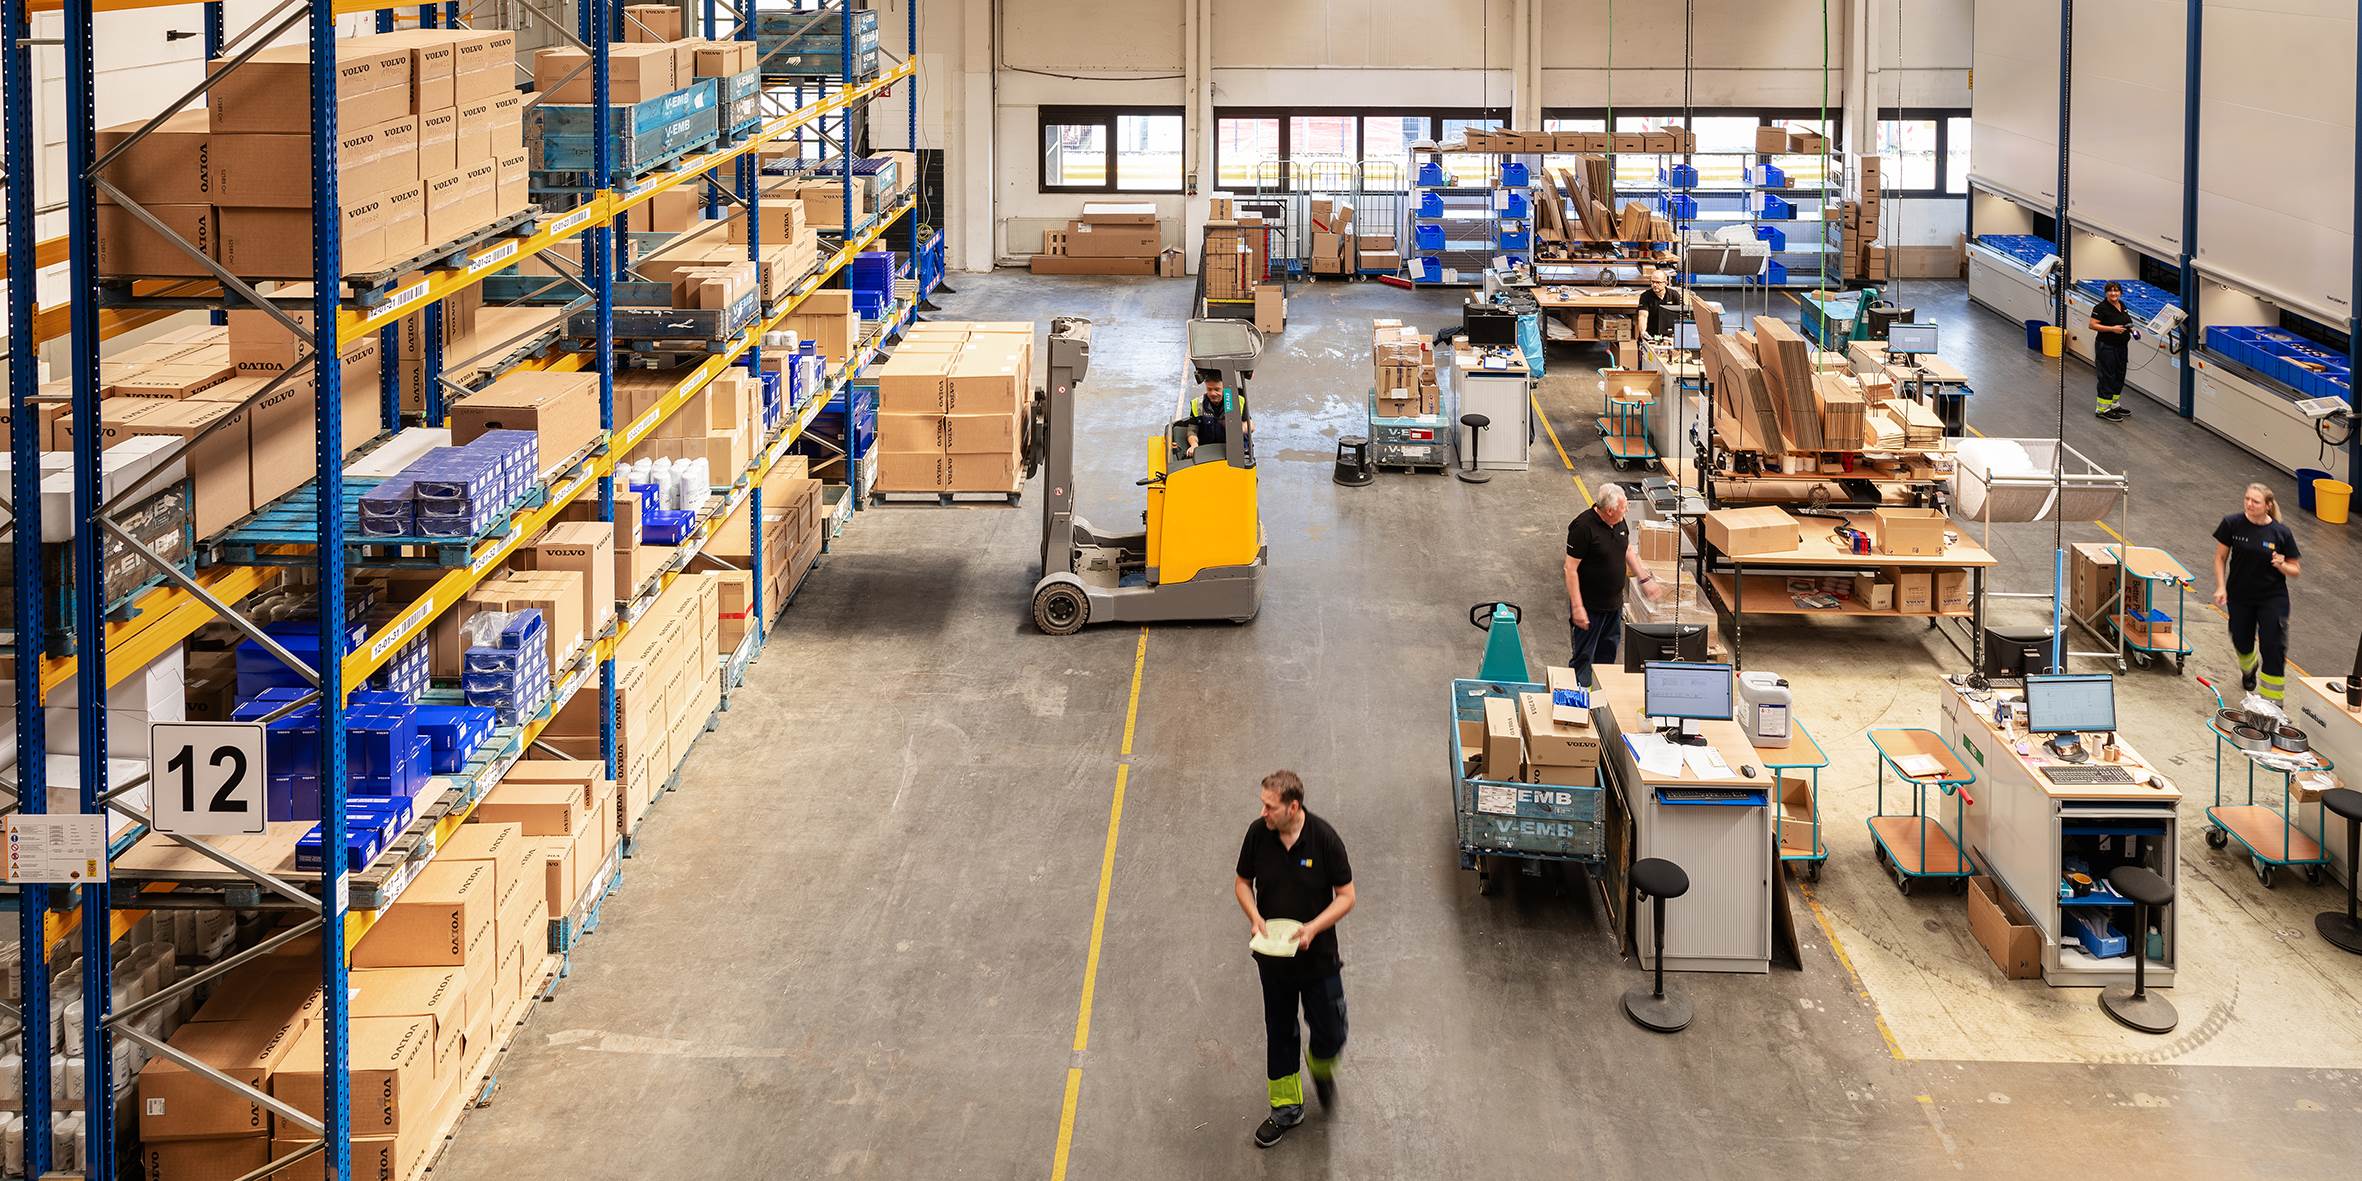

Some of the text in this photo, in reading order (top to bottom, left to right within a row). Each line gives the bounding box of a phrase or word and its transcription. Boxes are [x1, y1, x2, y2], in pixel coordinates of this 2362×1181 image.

[460, 44, 483, 54] VOLVO
[490, 38, 511, 48] VOLVO
[380, 56, 406, 69] VOLVO
[425, 49, 449, 61] VOLVO
[342, 64, 370, 77] VOLVO
[736, 72, 755, 88] V-EMB
[495, 98, 518, 109] VOLVO
[665, 92, 690, 110] V-EMB
[736, 98, 755, 112] V-B
[463, 105, 486, 117] VOLVO
[425, 115, 451, 127] VOLVO
[665, 120, 690, 137] V-EMB
[384, 124, 412, 138] VOLVO
[343, 134, 374, 149] VOLVO
[200, 142, 209, 193] VOLVO
[502, 156, 525, 168] VOLVO
[467, 166, 492, 178] VOLVO
[433, 176, 459, 190] VOLVO
[390, 189, 419, 204] VOLVO
[349, 202, 379, 218] VOLVO
[198, 216, 207, 255] VOLV
[345, 346, 374, 366] VOLVO
[238, 362, 285, 371] VOLVO
[259, 388, 295, 410] VOLVO
[1388, 446, 1432, 454] V-B
[374, 629, 400, 654] 12-01-31
[166, 744, 249, 812] 12
[1518, 790, 1572, 805] EMB
[1496, 820, 1575, 838] V-EMB
[489, 827, 512, 852] VOLVO
[458, 865, 484, 895] VOLVO
[451, 910, 459, 955] VOLVO
[428, 974, 453, 1007] VOLVO
[260, 1023, 292, 1060] VOLVO
[391, 1022, 420, 1061] VOLVO
[404, 1029, 430, 1068] VOLVO
[251, 1076, 260, 1126] VVO
[384, 1076, 392, 1126] VOLVO
[152, 1152, 160, 1181] OLVO
